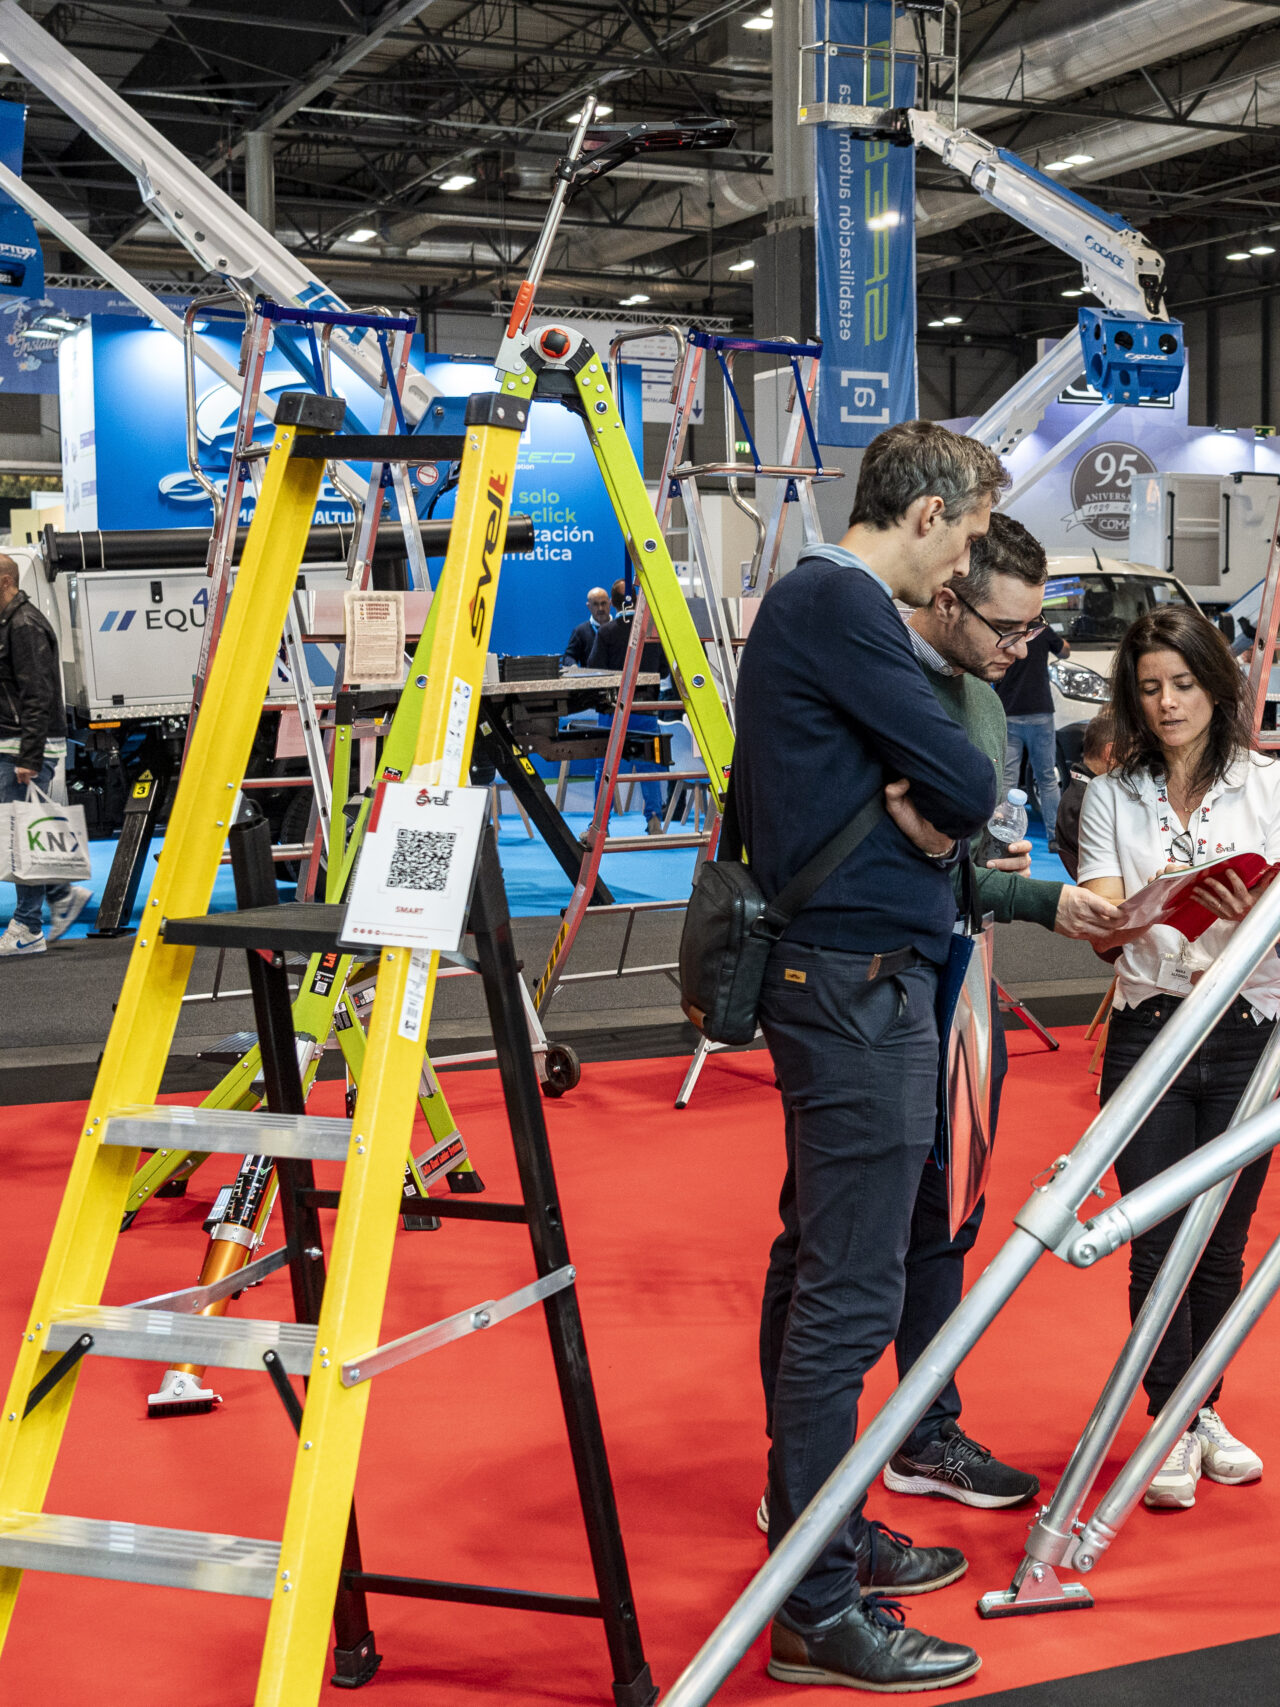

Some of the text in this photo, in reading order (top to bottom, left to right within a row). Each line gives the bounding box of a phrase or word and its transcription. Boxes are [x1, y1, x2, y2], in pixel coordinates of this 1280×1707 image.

[1094, 452, 1138, 488] 95
[518, 488, 560, 504] solo
[531, 507, 577, 523] click
[533, 525, 594, 543] zación
[192, 588, 209, 609] 4
[145, 608, 208, 632] EQU
[136, 785, 146, 795] 3
[395, 906, 424, 915] SMART
